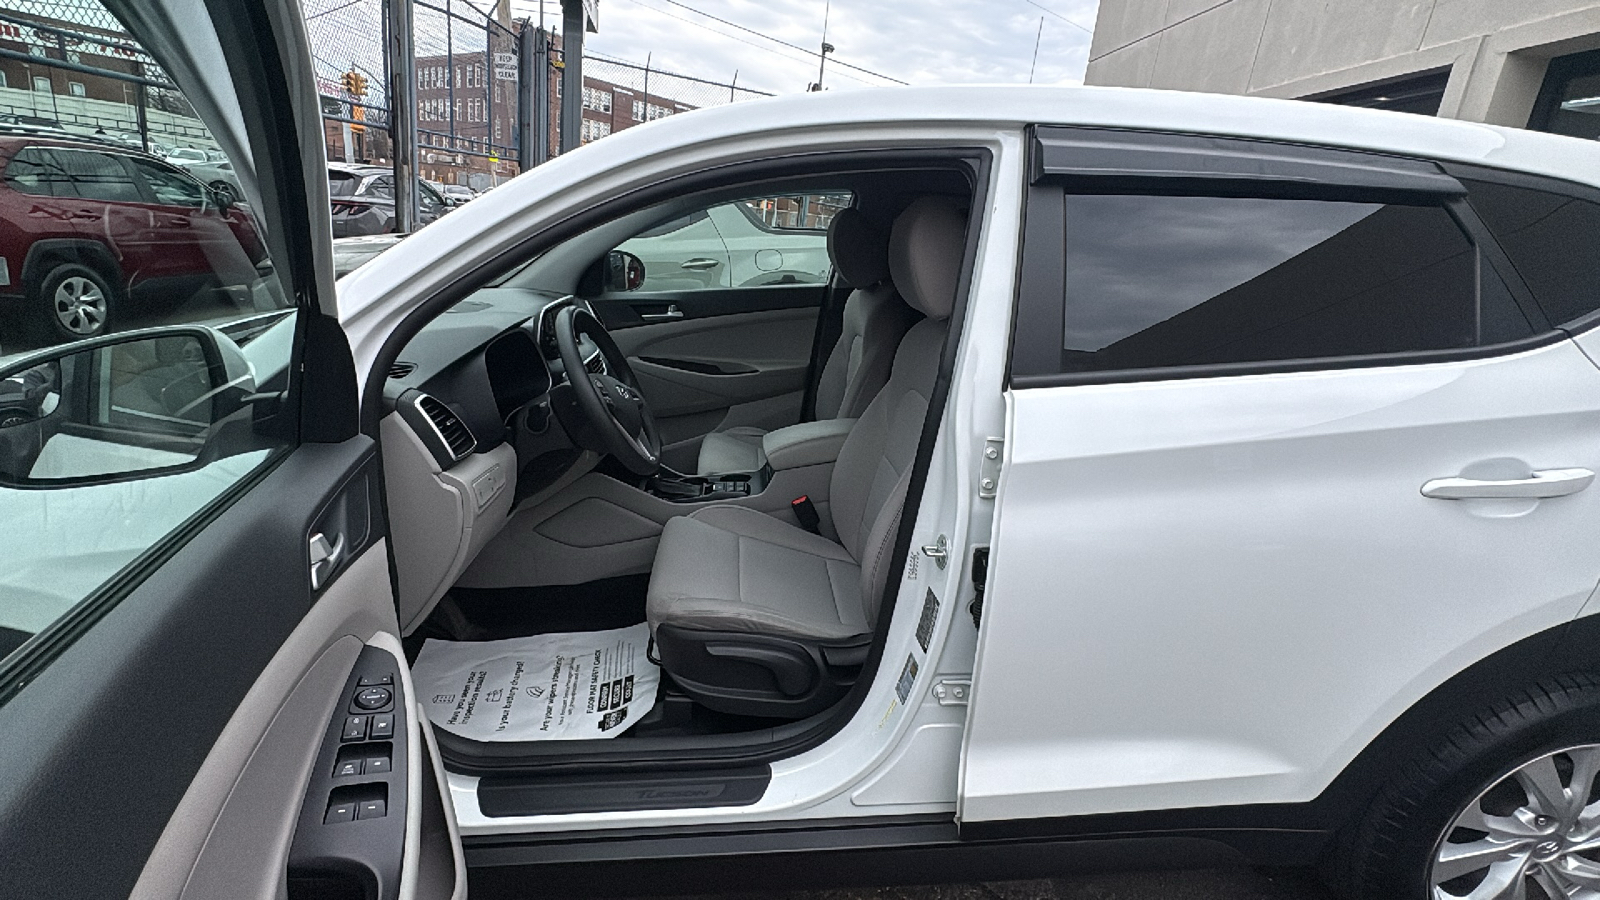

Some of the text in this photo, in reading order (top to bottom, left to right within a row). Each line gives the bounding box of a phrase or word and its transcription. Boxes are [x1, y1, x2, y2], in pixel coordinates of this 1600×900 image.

[586, 649, 602, 714] FLOOR MAT SAFETY CHECK
[447, 671, 477, 725] Have you seen your
[459, 671, 487, 724] inspection results?
[502, 686, 518, 709] battery
[540, 655, 565, 732] Are your wipers streaking?
[599, 686, 609, 709] CONFIRM
[612, 684, 621, 704] SECURE
[500, 709, 510, 726] your
[637, 789, 710, 798] TUCSON
